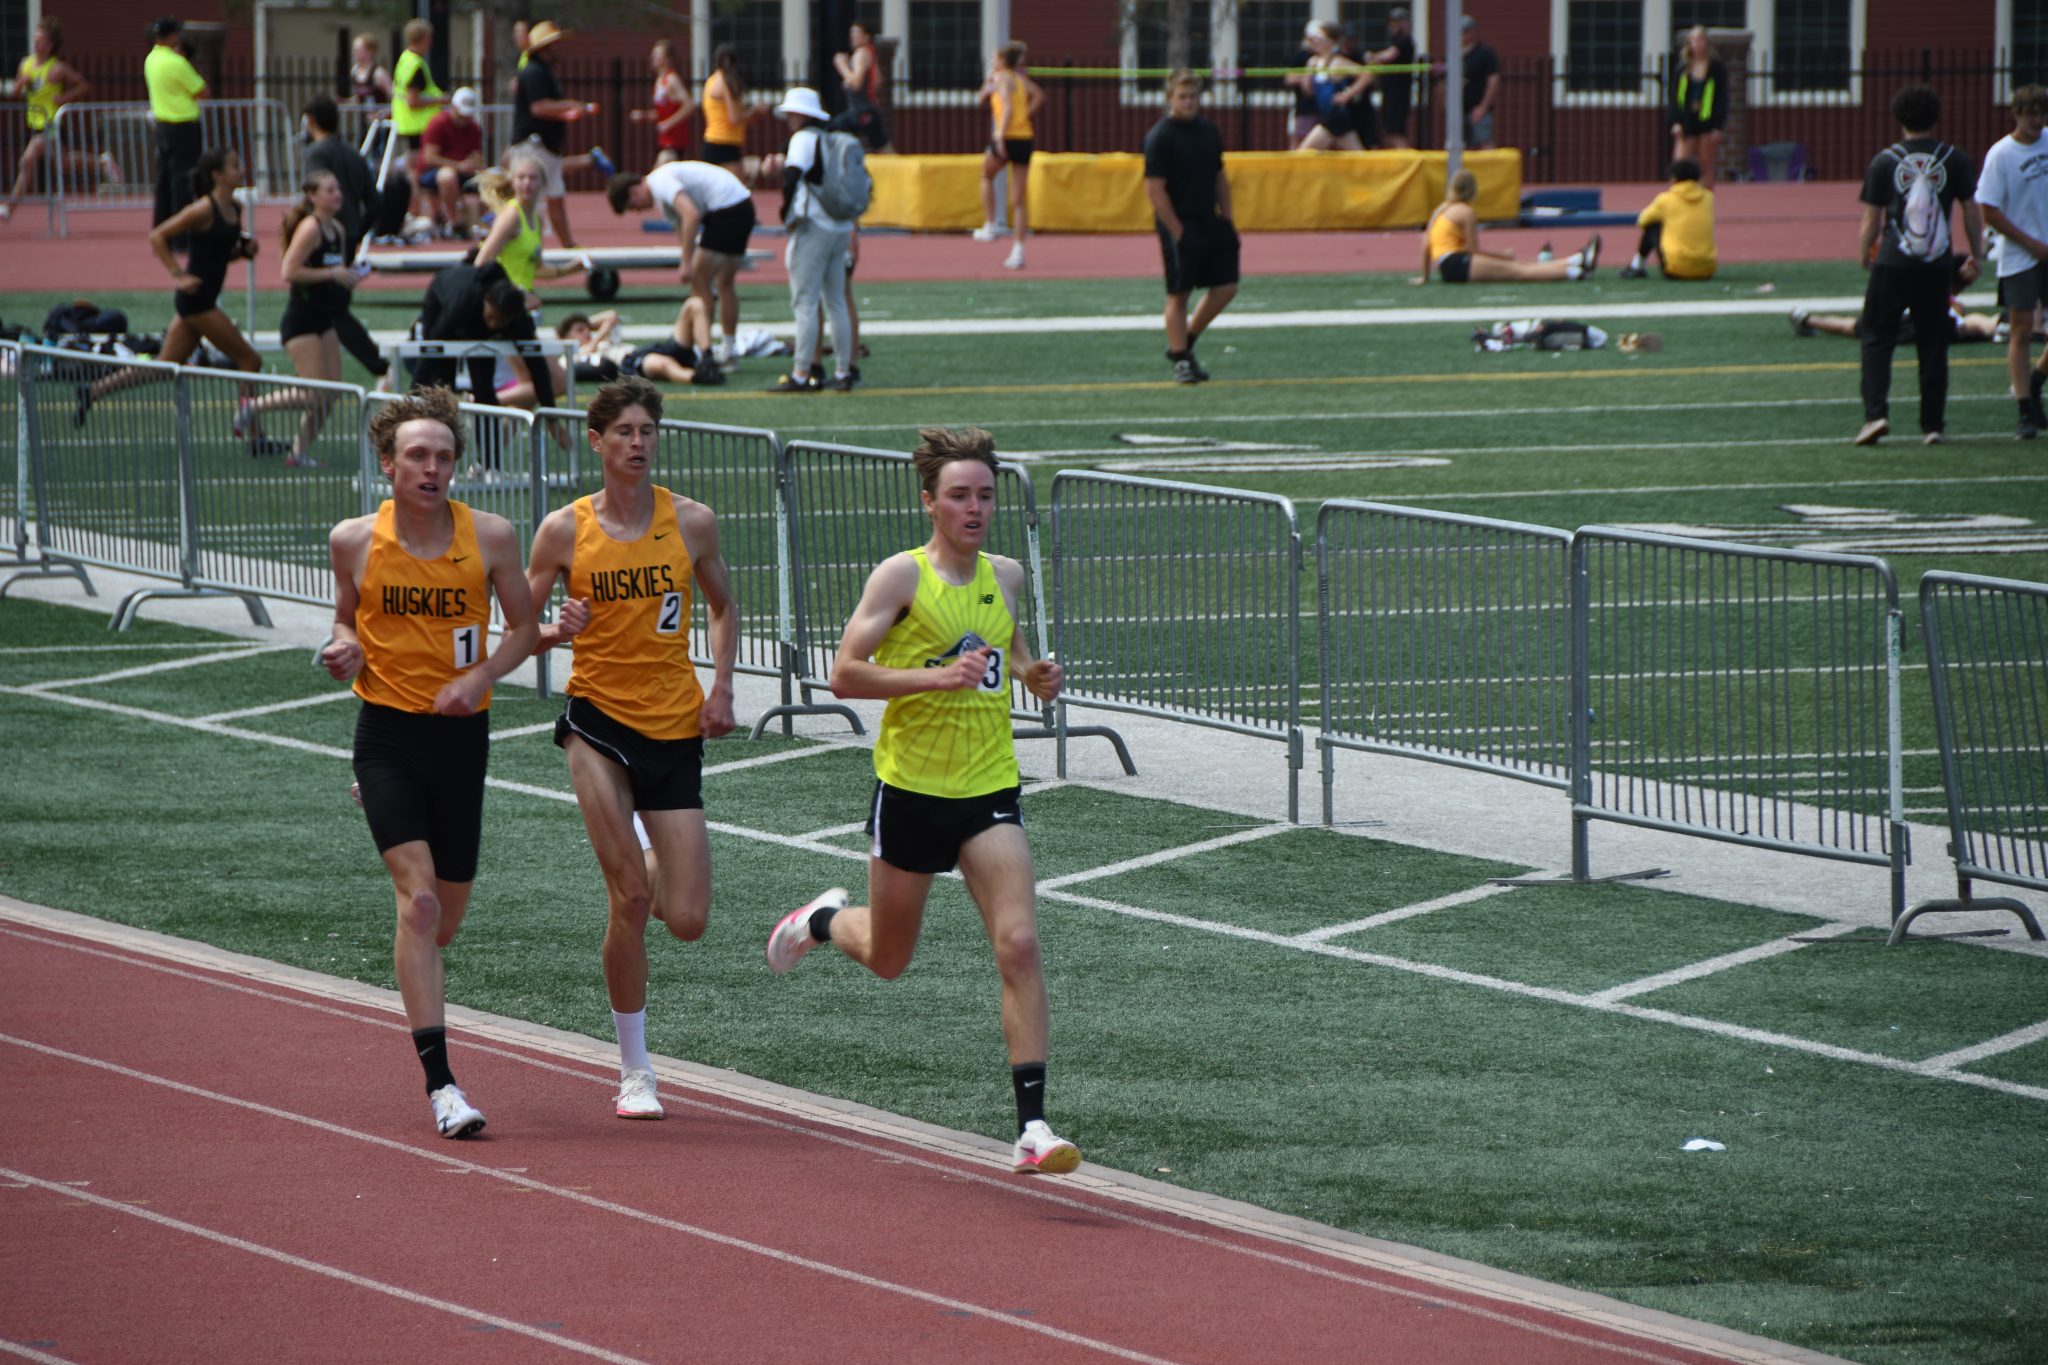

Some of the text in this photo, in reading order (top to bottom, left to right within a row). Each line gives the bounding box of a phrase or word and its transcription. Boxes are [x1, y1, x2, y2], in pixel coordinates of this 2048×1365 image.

[591, 564, 674, 602] HUSKIES
[382, 585, 466, 618] HUSKIES
[660, 595, 679, 630] 2
[458, 629, 472, 664] 1
[982, 650, 1000, 689] 3
